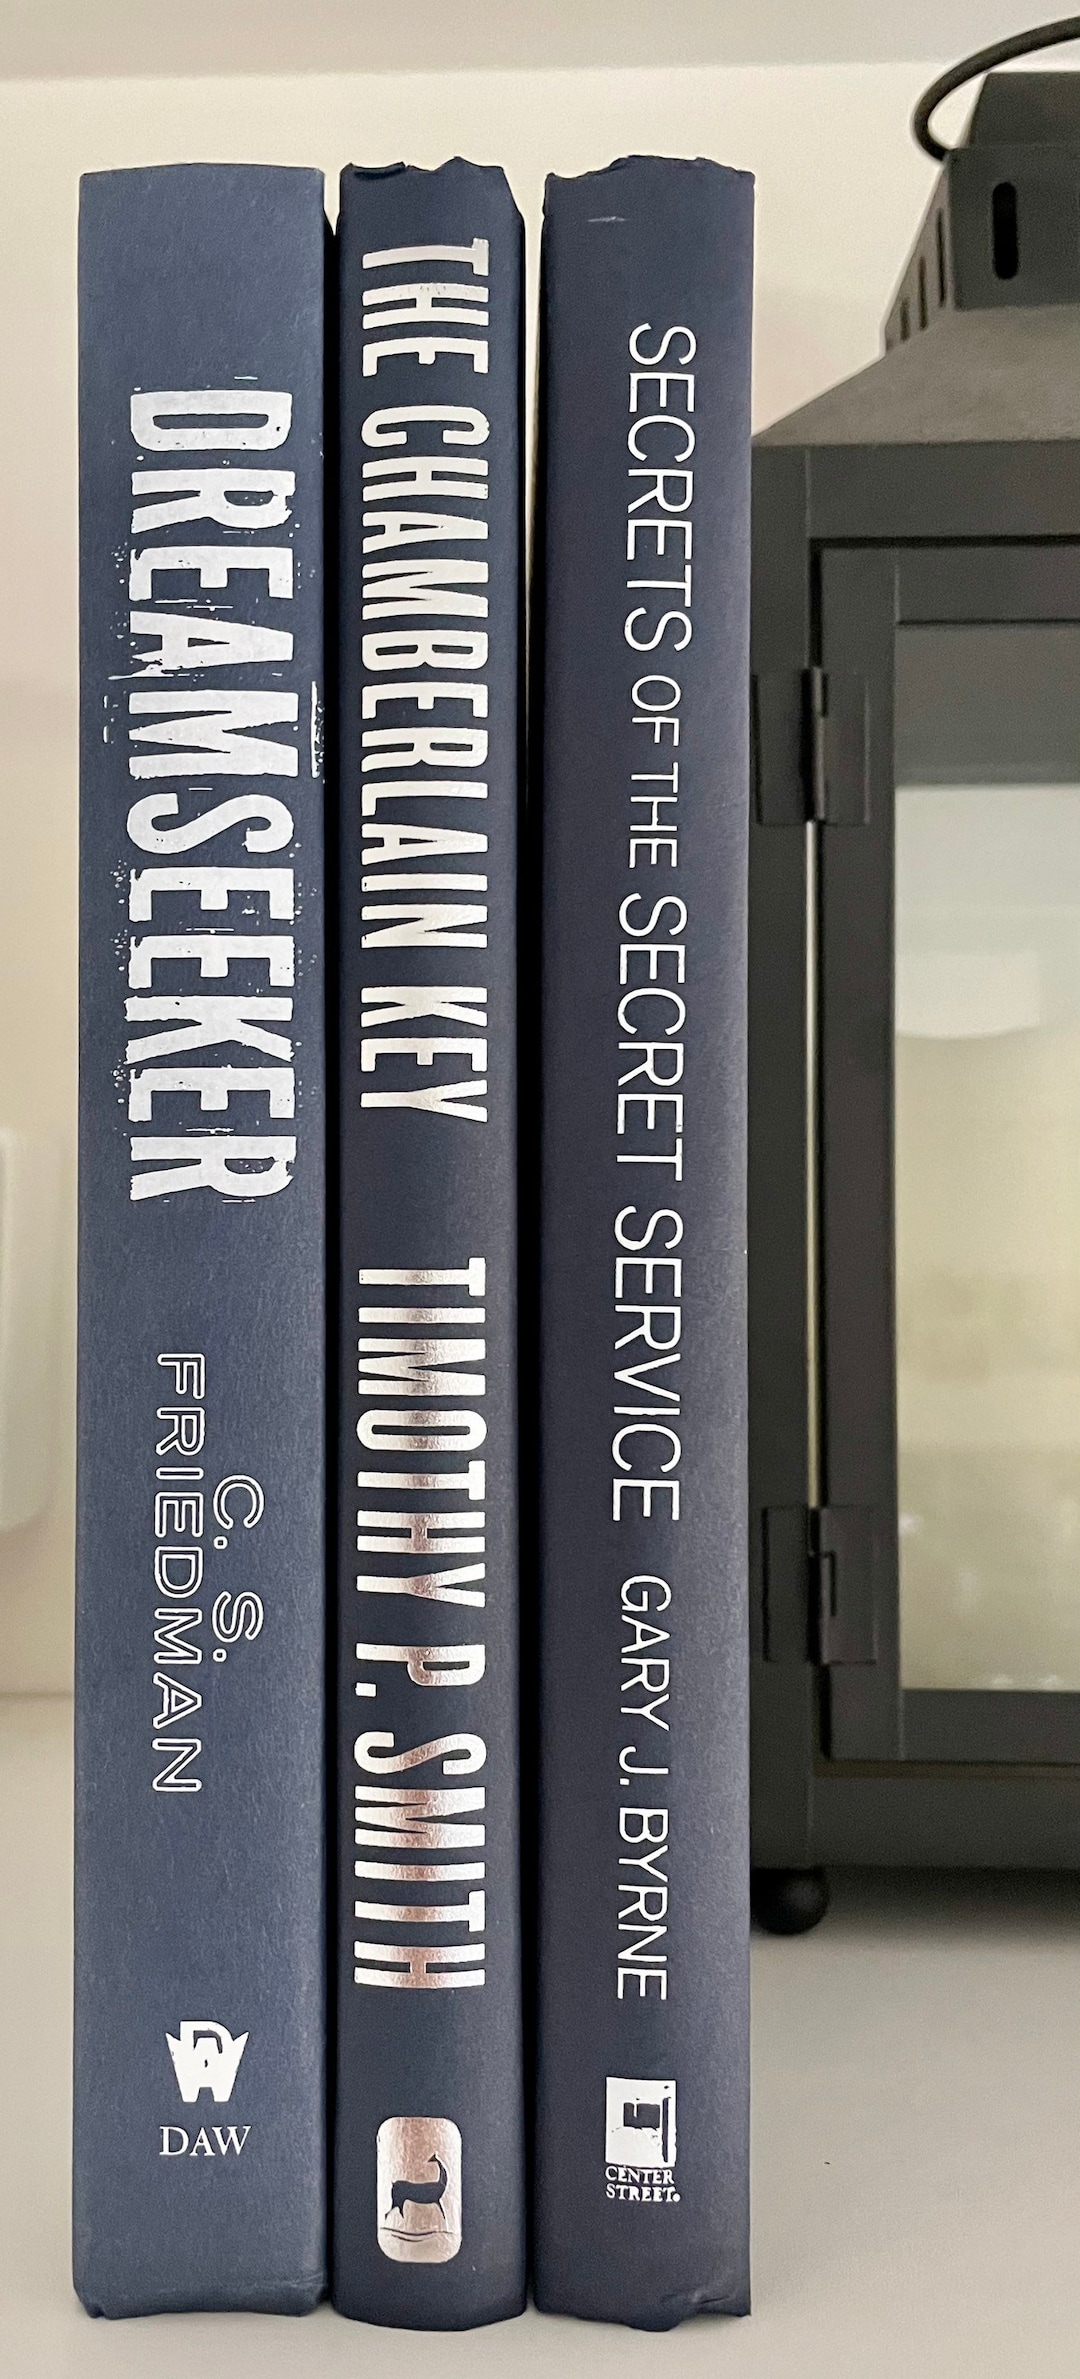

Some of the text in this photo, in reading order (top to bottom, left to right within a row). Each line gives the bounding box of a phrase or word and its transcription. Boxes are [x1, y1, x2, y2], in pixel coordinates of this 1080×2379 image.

[126, 387, 299, 1202] DREAMSEEKER
[360, 237, 490, 1123] THE CHAMBERLAIN KEY
[612, 322, 697, 1521] SECRETS OF THE SECRET SERVICE
[151, 1353, 206, 1792] FRIEDMAN
[211, 1474, 265, 1662] C. S.
[352, 1257, 487, 1992] TIMOTHY P. SMITH
[616, 1575, 672, 2000] GARY J. BYRNE
[158, 2125, 252, 2157] DAW
[605, 2165, 675, 2185] CENTER
